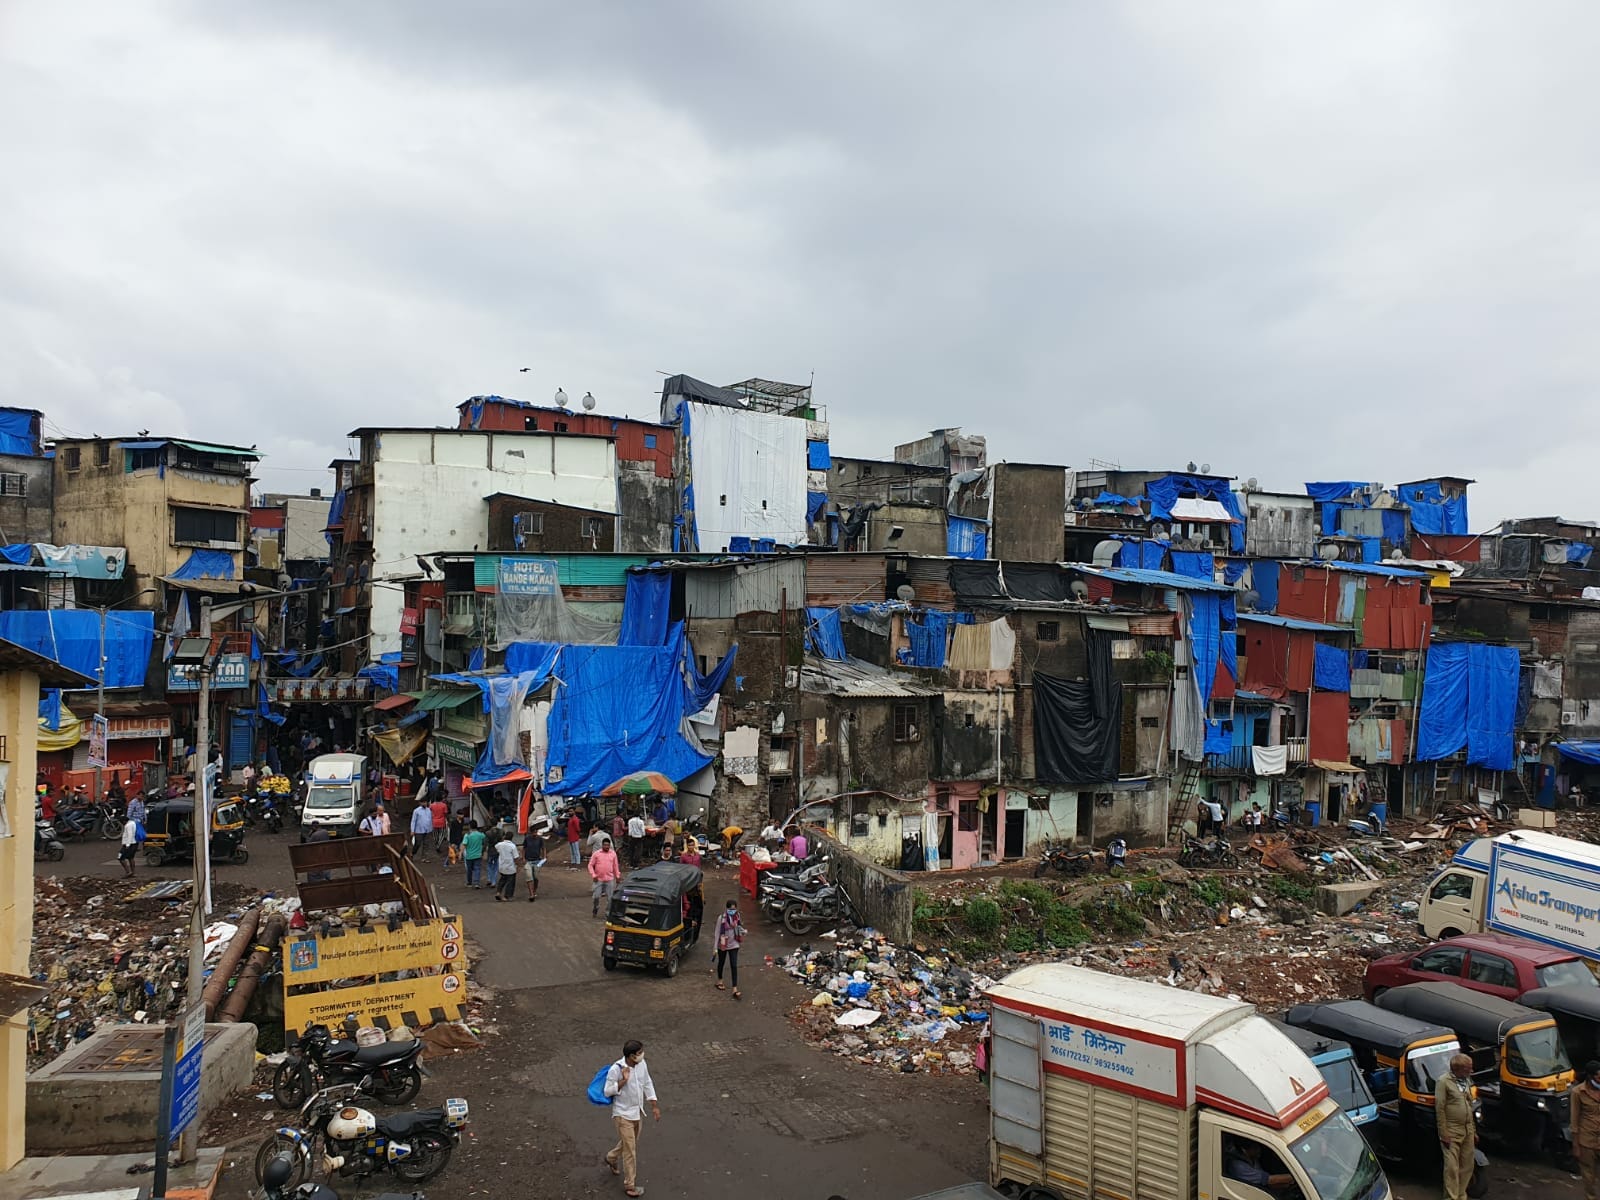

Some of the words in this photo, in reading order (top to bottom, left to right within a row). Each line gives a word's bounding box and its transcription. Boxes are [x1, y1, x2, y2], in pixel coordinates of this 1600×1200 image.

[513, 561, 545, 573] HOTEL
[529, 574, 554, 585] NAWAZ
[438, 742, 456, 758] HABIB
[456, 748, 472, 763] DAIRY
[1496, 877, 1538, 909] Aisha
[321, 951, 347, 961] Municipal
[347, 948, 379, 959] Corporation
[409, 940, 433, 948] Mumbai
[309, 1000, 362, 1015] STORMWATER
[365, 992, 416, 1005] DEPARTMENT
[367, 1003, 404, 1015] regretted
